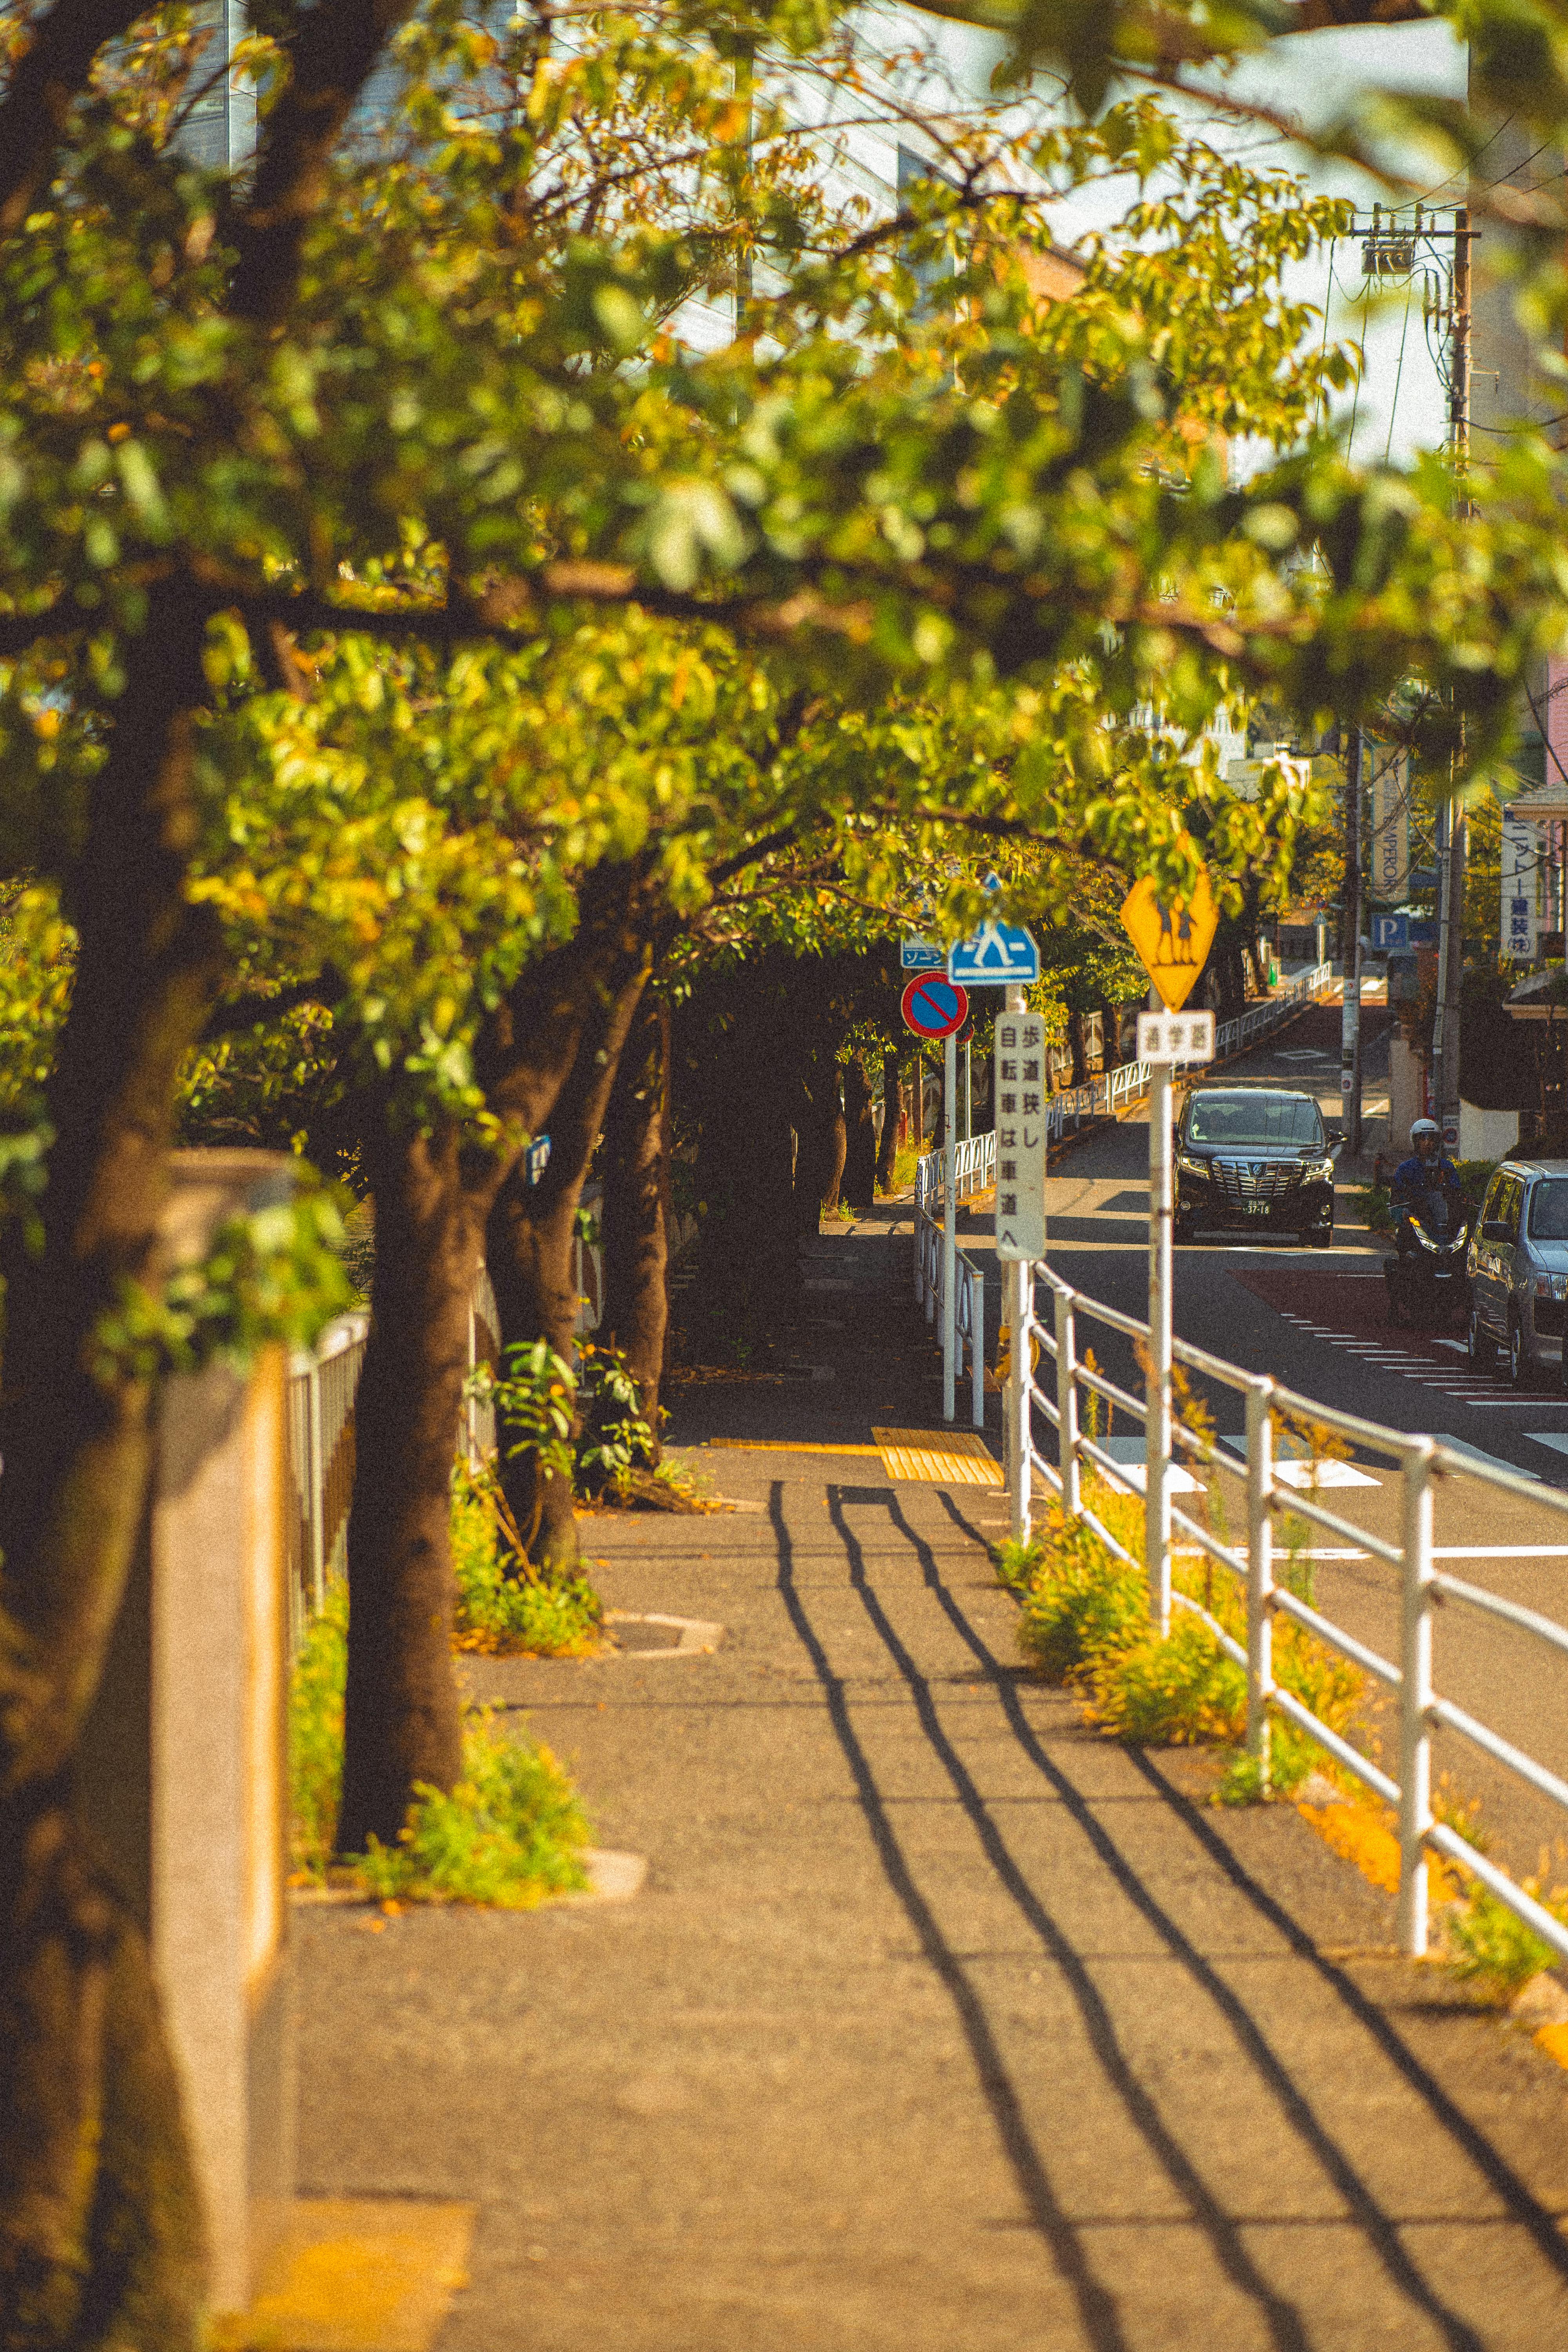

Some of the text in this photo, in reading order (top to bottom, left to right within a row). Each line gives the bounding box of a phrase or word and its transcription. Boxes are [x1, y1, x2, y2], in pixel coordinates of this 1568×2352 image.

[1379, 918, 1398, 945] P
[1022, 1025, 1039, 1148] 歩道狭し
[1000, 1026, 1018, 1247] 自転車は車道へ
[1248, 1205, 1269, 1214] 37-18
